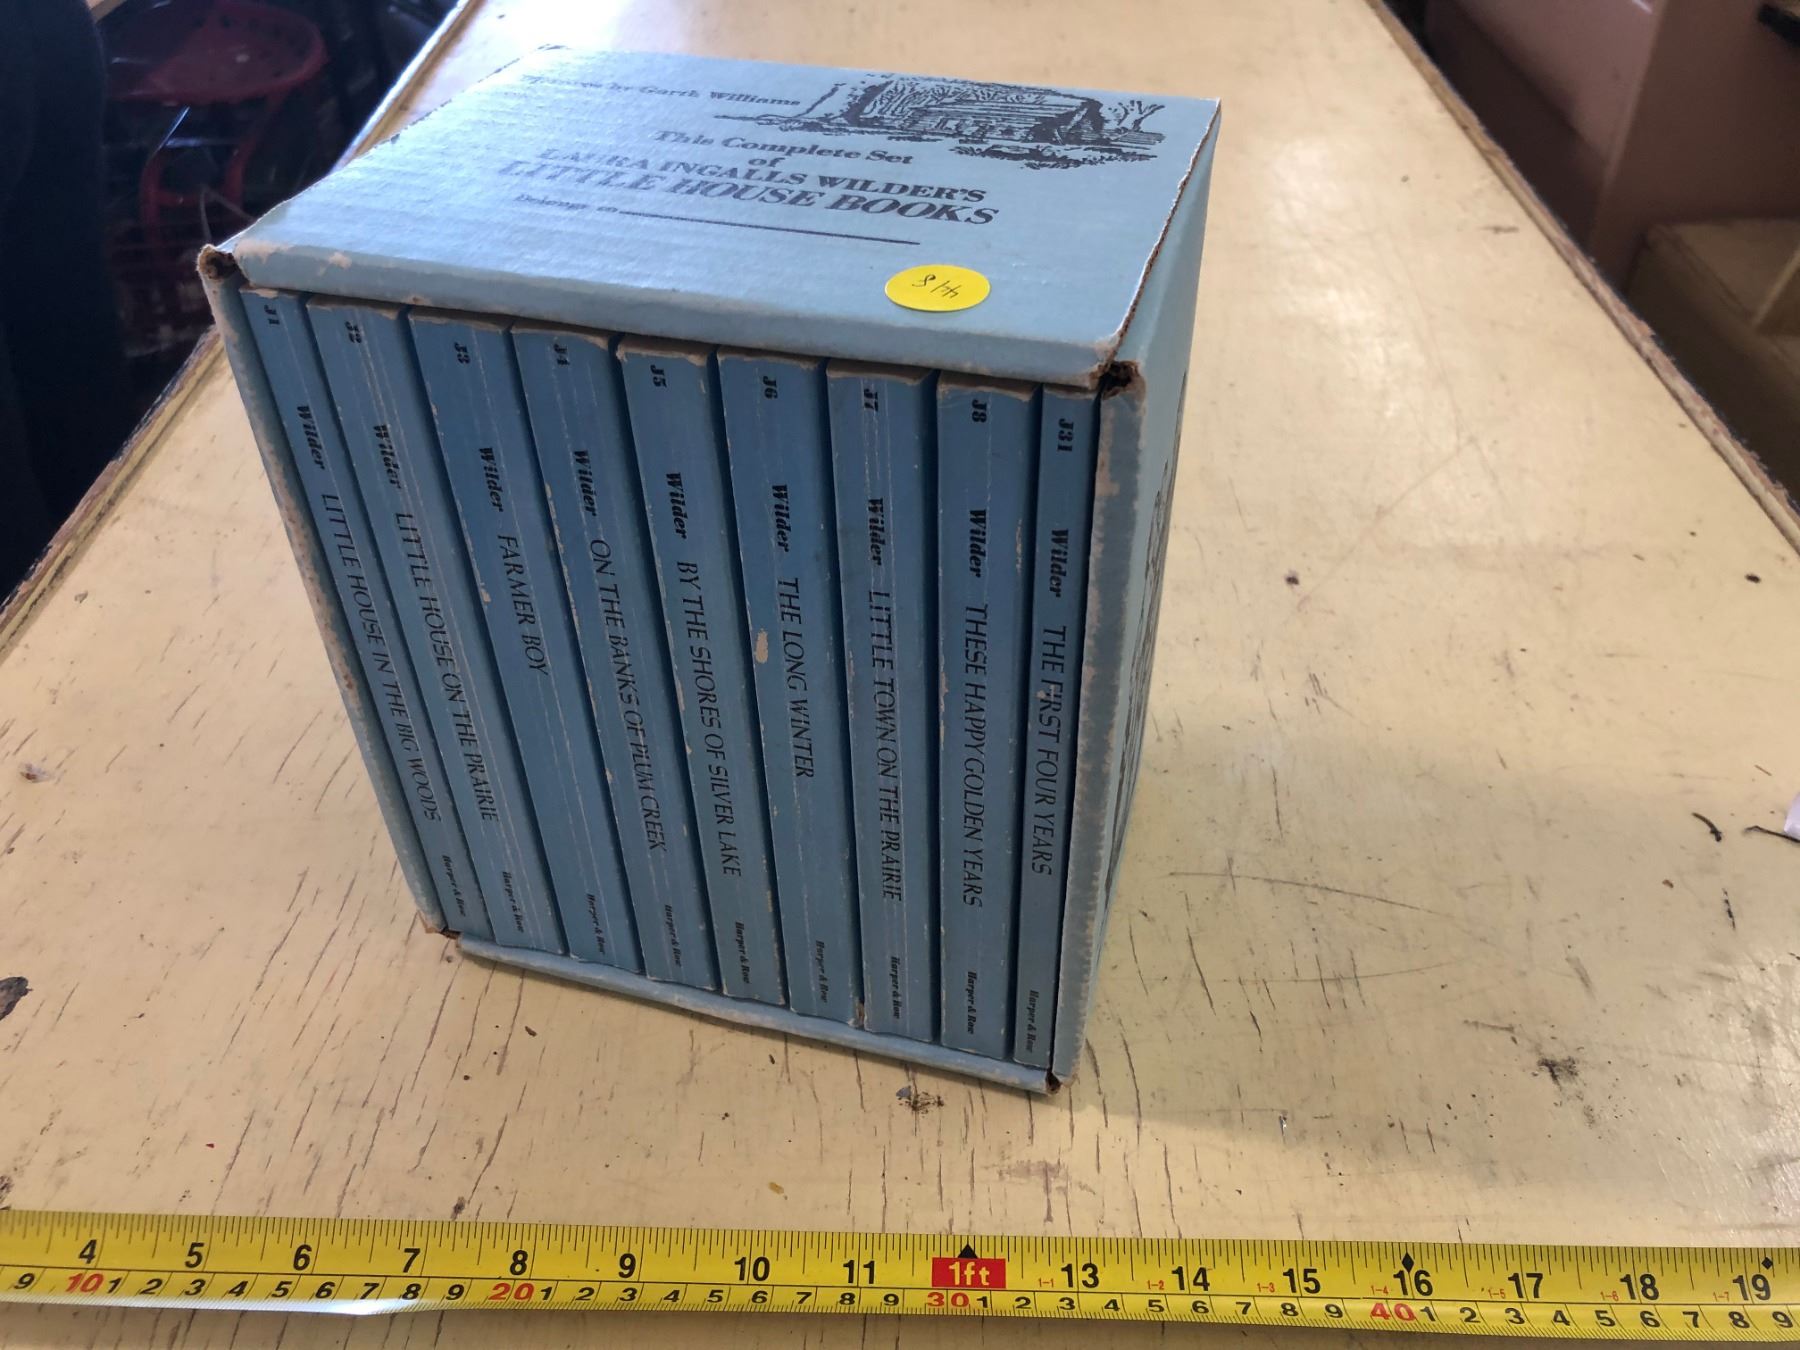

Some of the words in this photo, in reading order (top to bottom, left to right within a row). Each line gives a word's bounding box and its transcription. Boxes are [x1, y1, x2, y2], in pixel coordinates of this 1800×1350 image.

[710, 91, 800, 106] Williams
[653, 130, 714, 147] This
[720, 137, 861, 159] Complete
[866, 150, 913, 165] Set
[748, 156, 786, 169] of
[497, 160, 668, 192] LITTLE
[665, 178, 825, 207] HOUSE
[825, 194, 1000, 225] BOOKS
[657, 160, 808, 186] INGALLS
[818, 174, 987, 202] WILDER'S
[297, 405, 326, 470] Wilder
[373, 424, 402, 489] Wilder
[477, 447, 504, 512] Wilder
[574, 450, 597, 516] Wilder
[666, 472, 689, 539] Wilder
[772, 484, 792, 552] Wilder
[868, 498, 886, 566] Wilder
[969, 509, 987, 578] Wilder
[395, 512, 433, 588] LITTLE
[590, 539, 615, 576] ON
[677, 561, 701, 591] BY
[1049, 528, 1069, 598] Wilder
[419, 596, 456, 668] HOUSE
[497, 534, 537, 625] FARMER
[521, 633, 549, 675] BOY
[599, 583, 625, 629] THE
[682, 595, 708, 640] THE
[778, 577, 802, 625] THE
[868, 590, 894, 670] LITTLE
[321, 493, 362, 569] LITTLE
[348, 574, 386, 646] HOUSE
[372, 651, 394, 673] IN
[383, 681, 409, 718] THE
[407, 756, 442, 822] WOODS
[608, 633, 638, 706] BANKS
[782, 633, 807, 691] LONG
[965, 603, 988, 676] THESE
[1041, 625, 1067, 675] THE
[441, 673, 466, 703] ON
[690, 646, 722, 729] SHORES
[873, 678, 897, 744] TOWN
[1038, 679, 1063, 744] FIRST
[452, 710, 478, 748] THE
[623, 710, 646, 737] OF
[704, 734, 726, 761] OF
[788, 698, 814, 778] WINTER
[964, 683, 986, 758] HAPPY
[463, 753, 499, 822] PRAIRIE
[708, 764, 735, 825] SILVER
[876, 747, 898, 779] ON
[1035, 749, 1058, 805] FOUR
[640, 796, 667, 852] CREEK
[880, 785, 900, 825] THE
[963, 757, 985, 842] GOLDEN
[718, 831, 742, 877] LAKE
[880, 829, 902, 901] PRAIRIE
[1031, 813, 1055, 876] YEARS
[963, 848, 984, 908] YEARS
[967, 971, 977, 1004] Harper
[14, 1273, 35, 1290] 9
[65, 1273, 104, 1293] 10
[107, 1278, 122, 1293] 1
[139, 1279, 163, 1295] 2
[185, 1279, 206, 1296] 3
[229, 1280, 249, 1297] 4
[271, 1281, 293, 1298] 5
[315, 1281, 336, 1299] 6
[360, 1283, 379, 1300] 7
[402, 1283, 422, 1300] 8
[446, 1284, 465, 1300] 9
[488, 1283, 535, 1301] 20
[540, 1287, 553, 1301] 1
[575, 1287, 595, 1301] 2
[619, 1287, 638, 1302] 3
[664, 1290, 680, 1303] 4
[707, 1290, 724, 1303] 5
[751, 1291, 768, 1304] 6
[796, 1291, 812, 1305] 7
[839, 1292, 856, 1306] 8
[883, 1293, 900, 1306] 9
[927, 1292, 970, 1308] 30
[977, 1296, 989, 1309] 1
[1015, 1296, 1032, 1309] 2
[1058, 1297, 1076, 1311] 3
[1104, 1298, 1121, 1312] 4
[1148, 1299, 1165, 1313] 5
[1192, 1300, 1210, 1315] 6
[1235, 1301, 1252, 1316] 7
[1280, 1302, 1300, 1317] 8
[1324, 1303, 1344, 1319] 9
[1369, 1302, 1416, 1322] 40
[1420, 1306, 1437, 1322] 1
[1459, 1307, 1480, 1323] 2
[1504, 1307, 1526, 1325] 3
[1552, 1310, 1571, 1326] 4
[1595, 1310, 1616, 1327] 5
[1639, 1311, 1660, 1328] 6
[1682, 1311, 1699, 1328] 7
[1728, 1311, 1750, 1329] 8
[1772, 1311, 1794, 1329] 9
[79, 1239, 97, 1264] 4
[185, 1242, 204, 1268] 5
[293, 1244, 312, 1271] 6
[403, 1248, 420, 1273] 7
[510, 1250, 528, 1275] 8
[618, 1253, 636, 1278] 9
[734, 1257, 770, 1281] 10
[843, 1260, 876, 1284] 11
[949, 1262, 990, 1286] 1ft
[1061, 1263, 1099, 1288] 13
[1172, 1266, 1210, 1291] 14
[1283, 1268, 1321, 1294] 15
[1393, 1270, 1433, 1296] 16
[1508, 1273, 1543, 1298] 17
[1620, 1274, 1660, 1300] 18
[1732, 1275, 1771, 1301] 19
